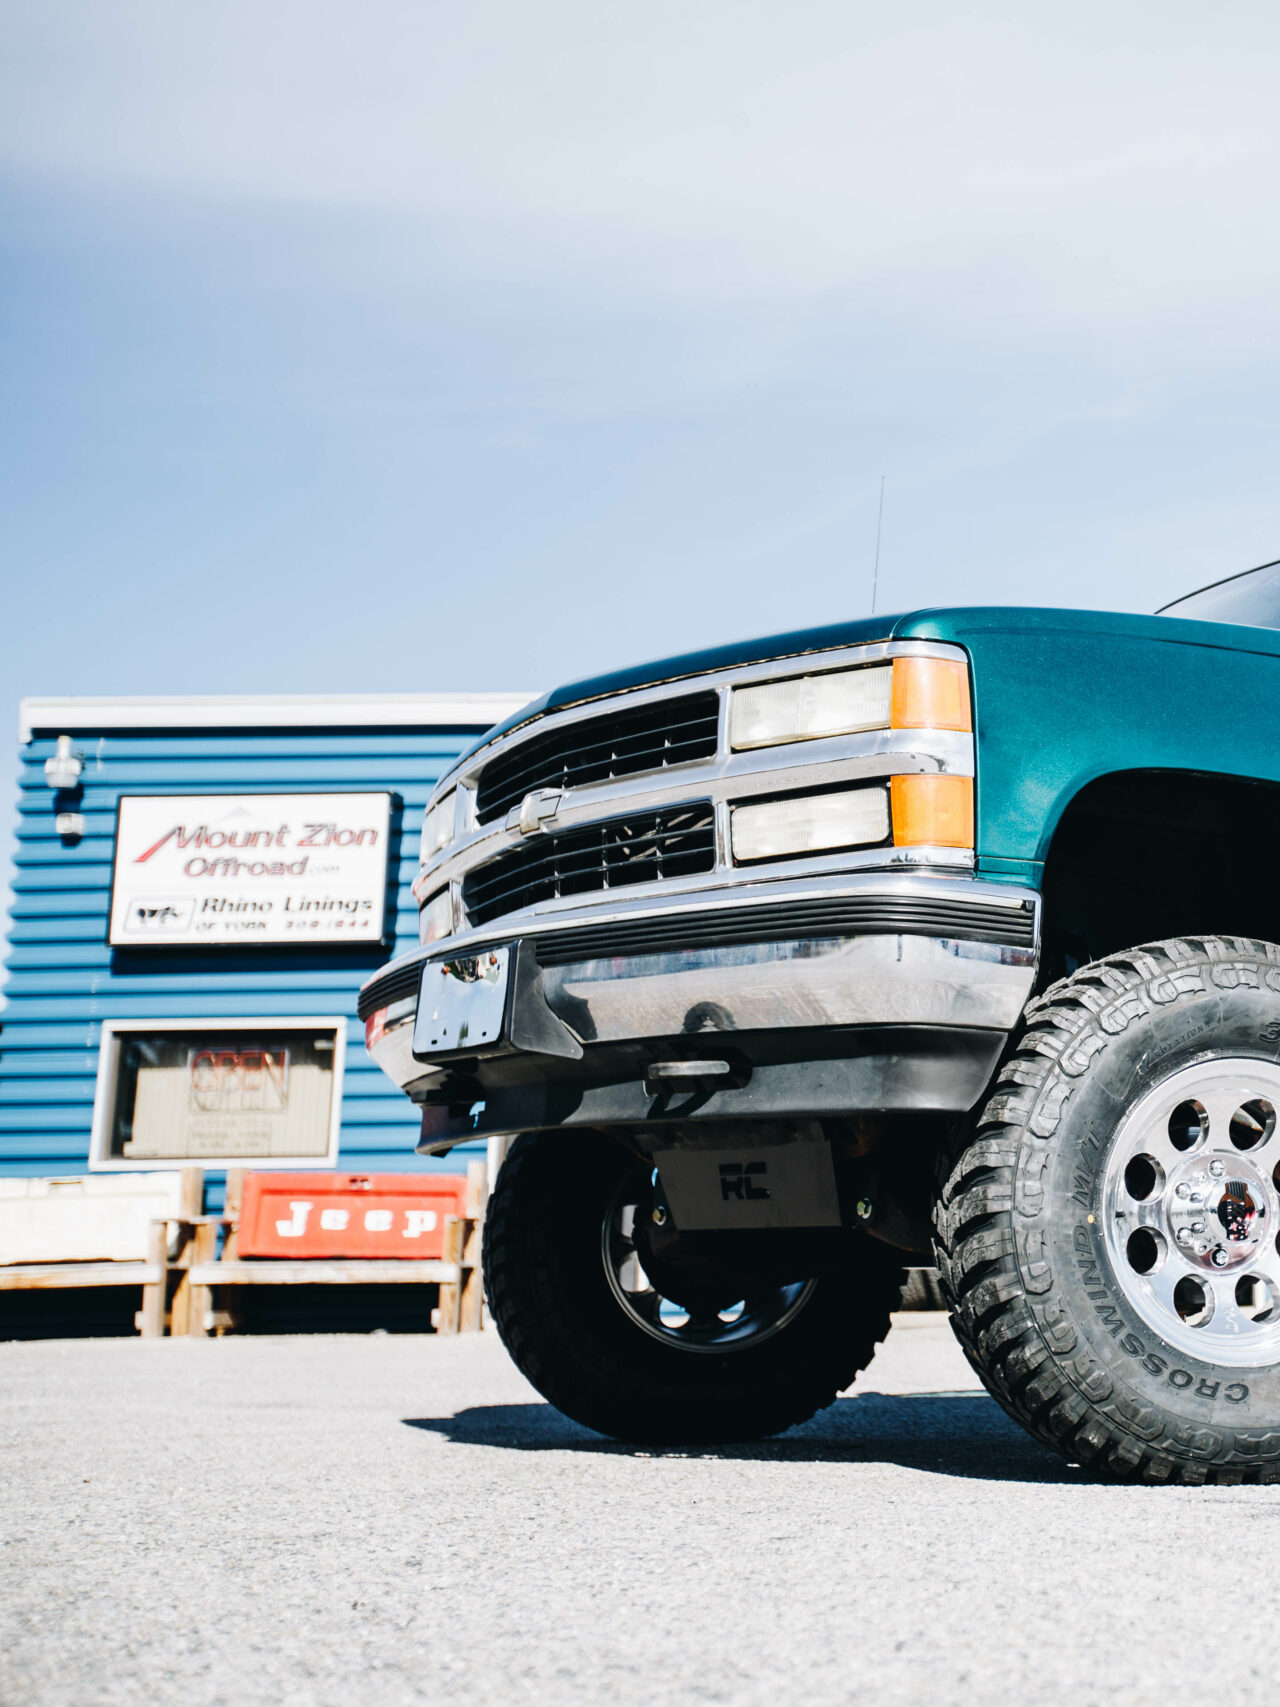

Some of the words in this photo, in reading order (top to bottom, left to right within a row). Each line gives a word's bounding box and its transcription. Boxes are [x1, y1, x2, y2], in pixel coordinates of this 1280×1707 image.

[133, 824, 291, 863] Mount
[297, 822, 379, 847] Zion
[201, 897, 273, 913] Rhino
[283, 895, 373, 914] Linings
[191, 1050, 287, 1100] OPEN
[276, 1201, 437, 1238] Jeep
[1073, 1224, 1250, 1405] CROSSWIND
